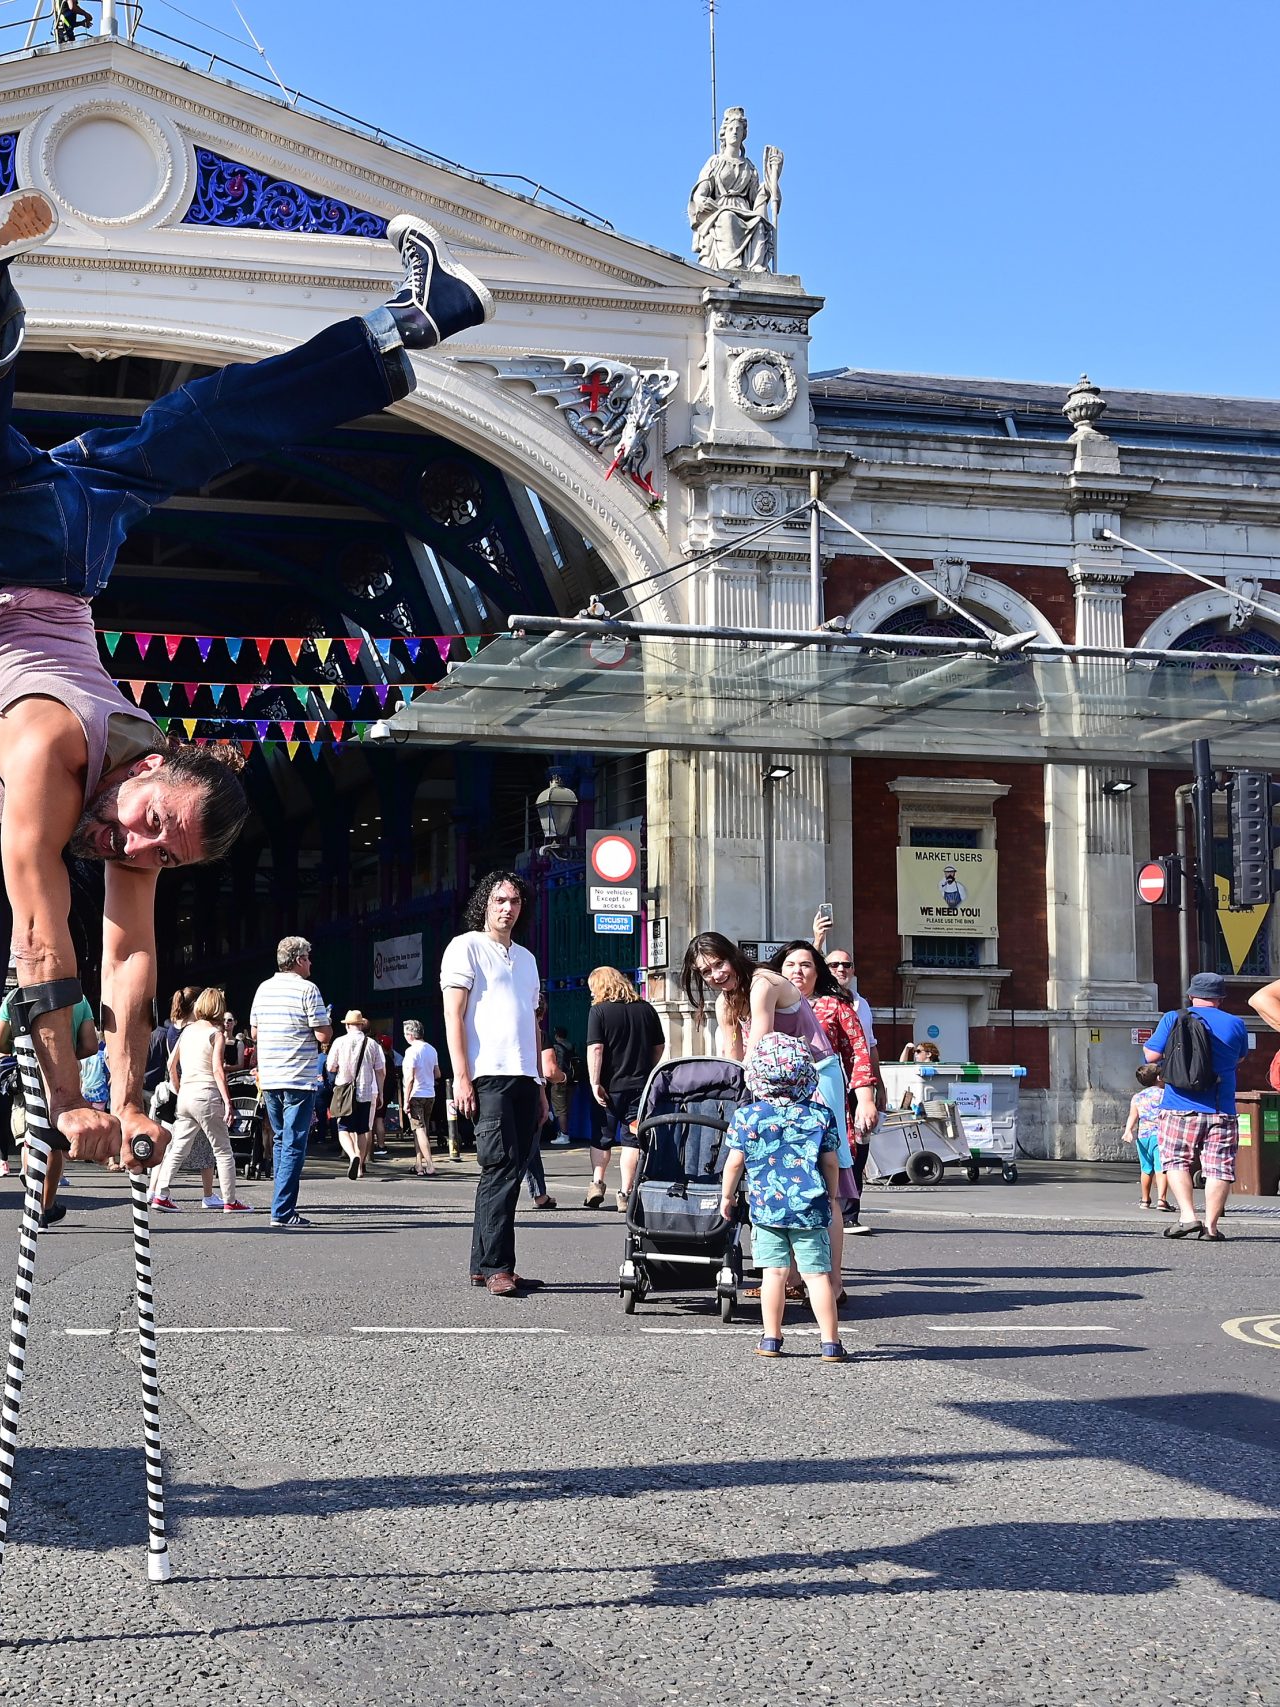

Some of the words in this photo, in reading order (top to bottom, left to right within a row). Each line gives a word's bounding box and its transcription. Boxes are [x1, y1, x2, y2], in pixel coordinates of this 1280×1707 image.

[915, 852, 952, 862] MARKET
[954, 853, 983, 862] USERS
[920, 907, 934, 916] WE
[936, 908, 958, 916] NEED
[960, 908, 980, 917] YOU!
[1090, 1029, 1100, 1042] H
